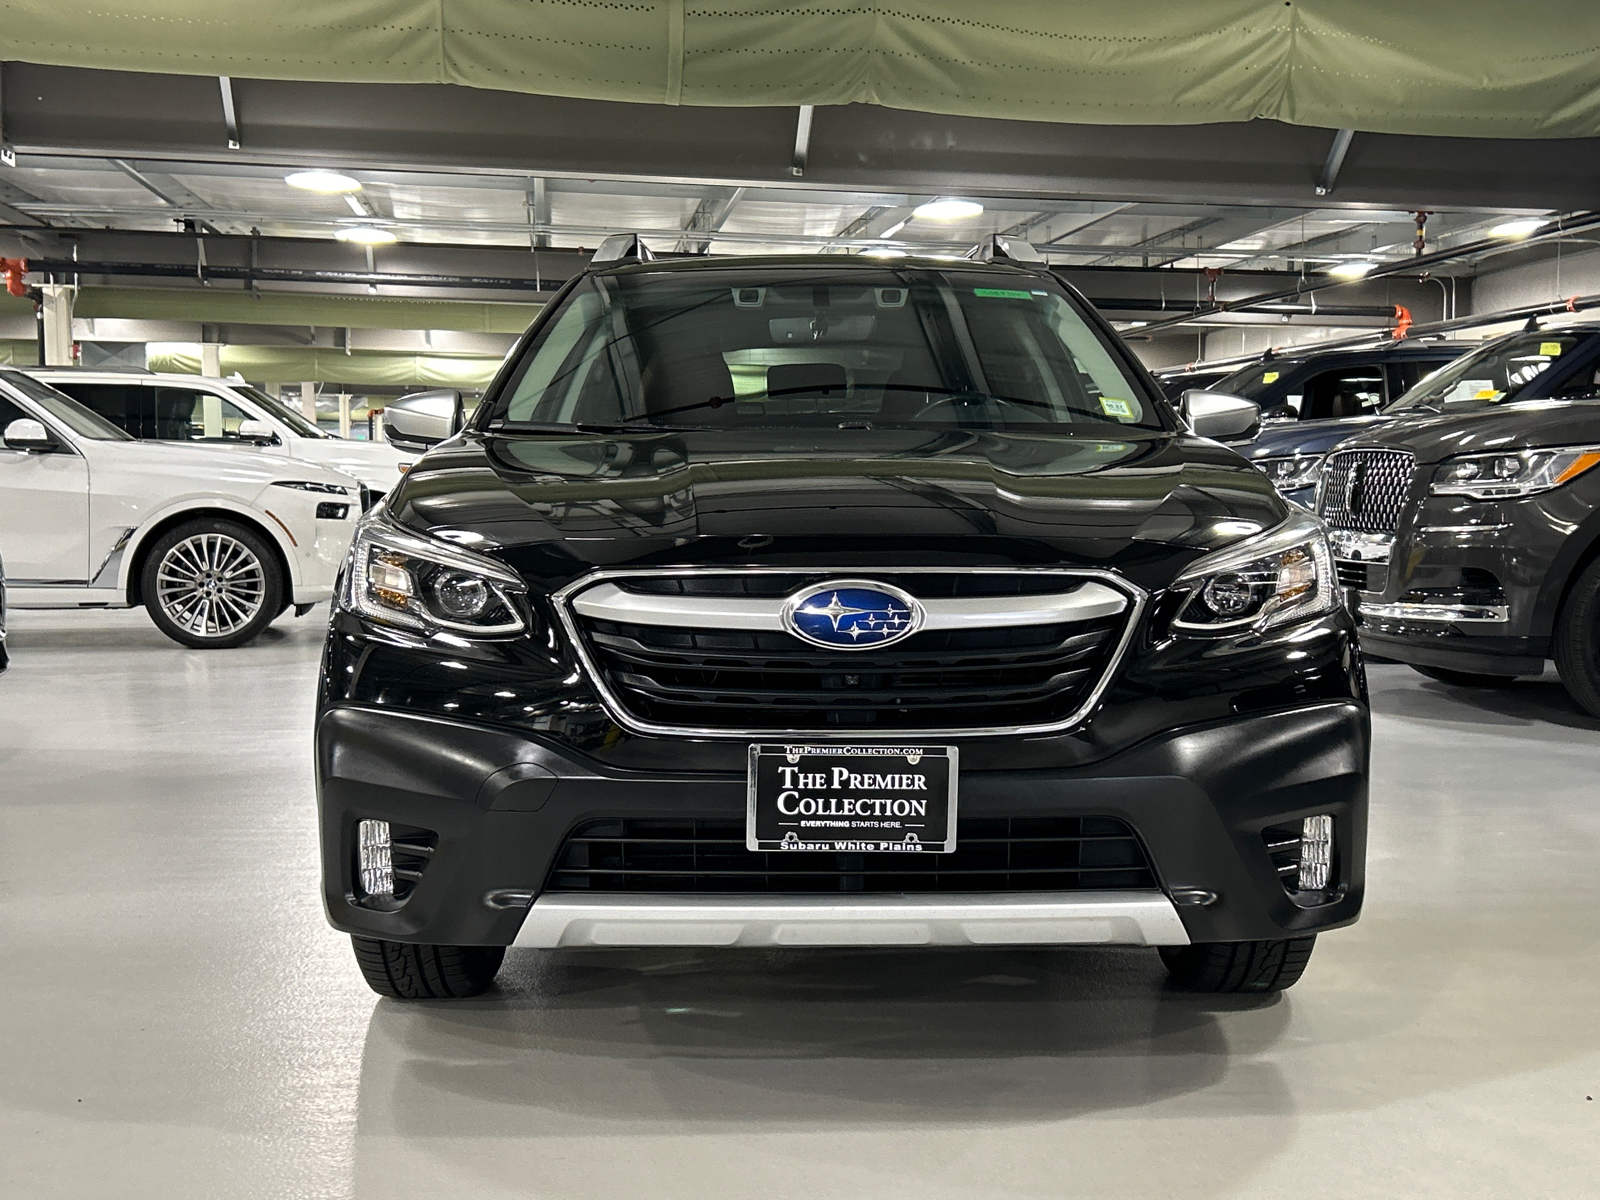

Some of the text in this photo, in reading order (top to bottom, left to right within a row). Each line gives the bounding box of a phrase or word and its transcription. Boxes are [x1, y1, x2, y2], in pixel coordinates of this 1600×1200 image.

[778, 766, 927, 790] THE PREMIER
[777, 791, 927, 816] COLLECTION
[800, 820, 850, 828] EVERYTHING
[780, 841, 923, 851] Subaru White Plains
